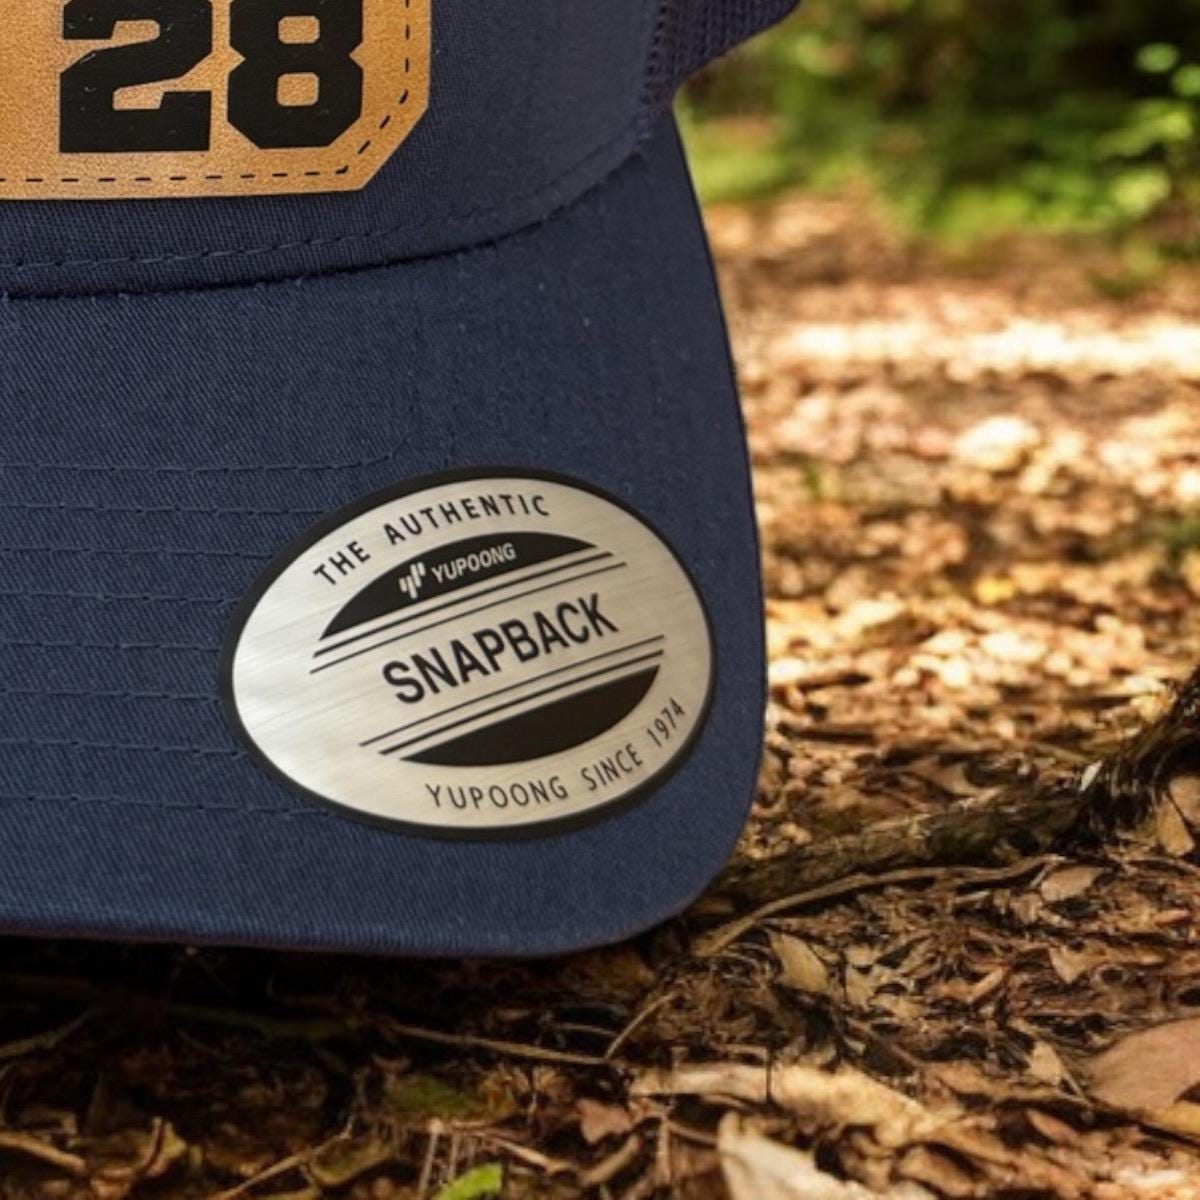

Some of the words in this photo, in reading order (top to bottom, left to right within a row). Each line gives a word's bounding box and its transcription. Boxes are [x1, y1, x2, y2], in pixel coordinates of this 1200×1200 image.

[313, 540, 371, 587] THE
[382, 493, 551, 546] AUTHENTIC
[431, 542, 517, 585] YUPOONG
[382, 592, 619, 705] SNAPBACK
[425, 776, 569, 810] YUPOONG
[581, 742, 643, 792] SINCE
[646, 696, 687, 749] 1974
